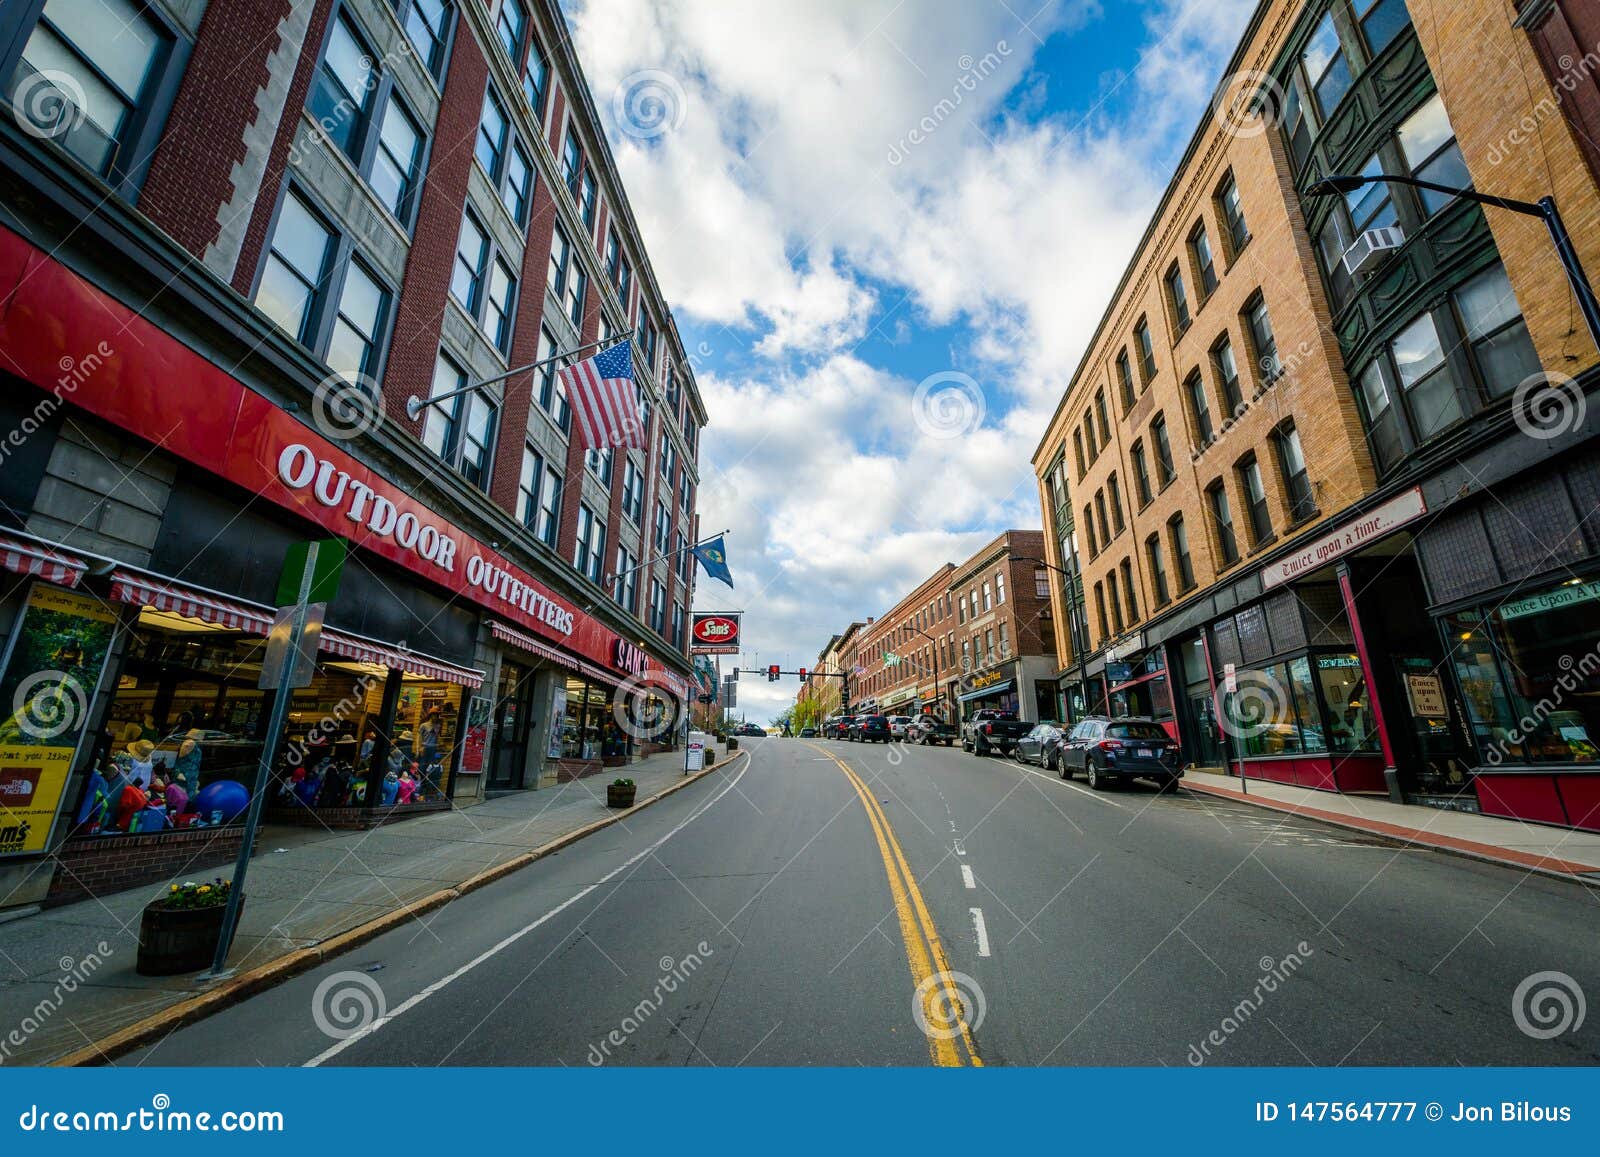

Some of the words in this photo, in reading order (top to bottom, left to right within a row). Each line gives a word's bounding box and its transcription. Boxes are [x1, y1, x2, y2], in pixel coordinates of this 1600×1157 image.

[278, 444, 457, 572] OUTDOOR
[467, 555, 574, 636] OUTFITTERS
[1281, 552, 1314, 577] Twice
[1316, 538, 1342, 562] upon
[1501, 602, 1538, 617] Twice
[1540, 591, 1573, 609] Upon
[1576, 586, 1589, 599] A
[702, 620, 729, 637] Sam's
[617, 638, 649, 681] SAM'S
